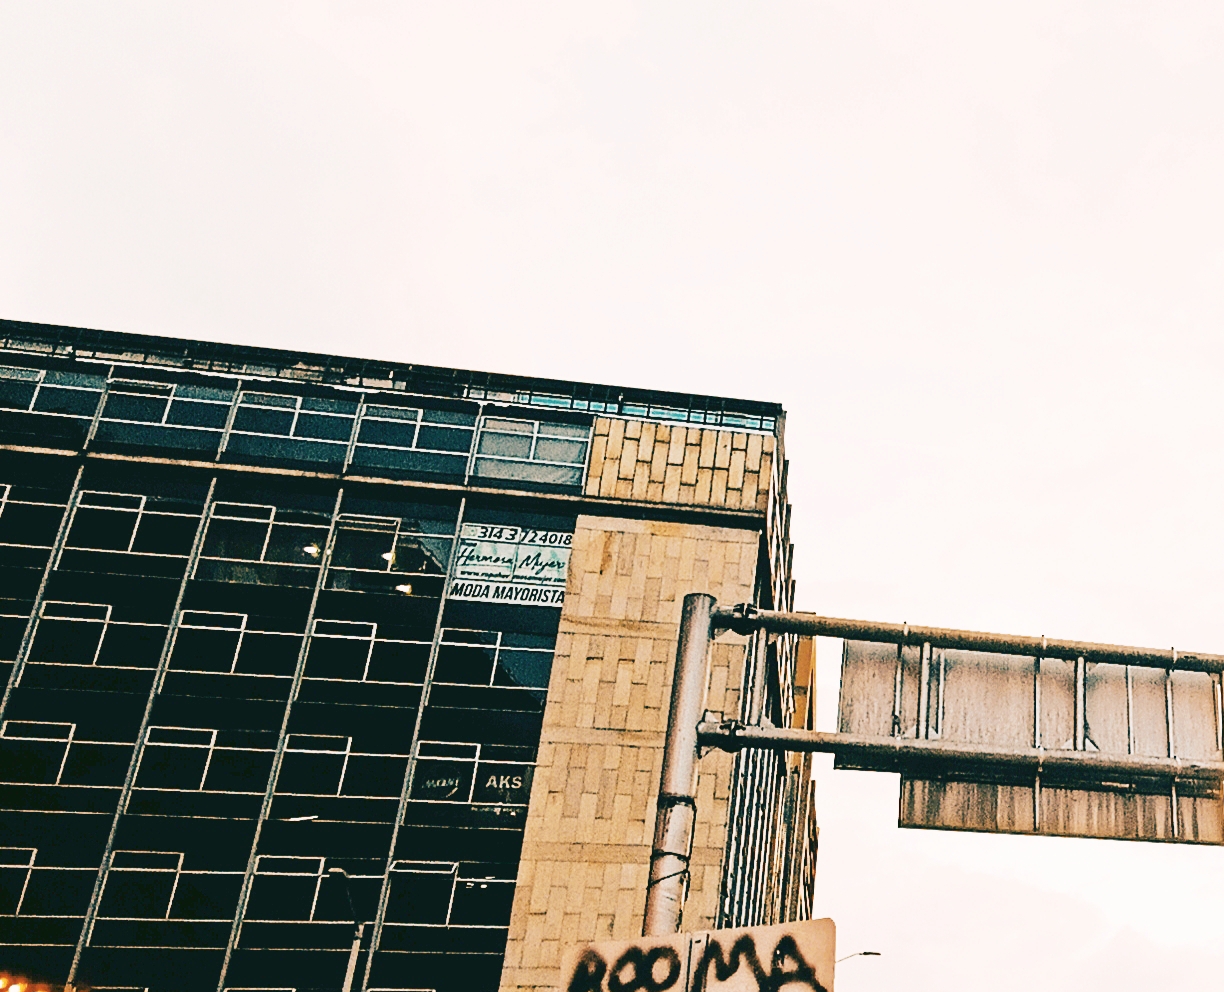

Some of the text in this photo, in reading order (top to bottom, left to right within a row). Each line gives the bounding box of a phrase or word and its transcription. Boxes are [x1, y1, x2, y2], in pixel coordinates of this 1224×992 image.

[450, 582, 565, 604] MODA MAYORISTA
[485, 775, 522, 789] AKS
